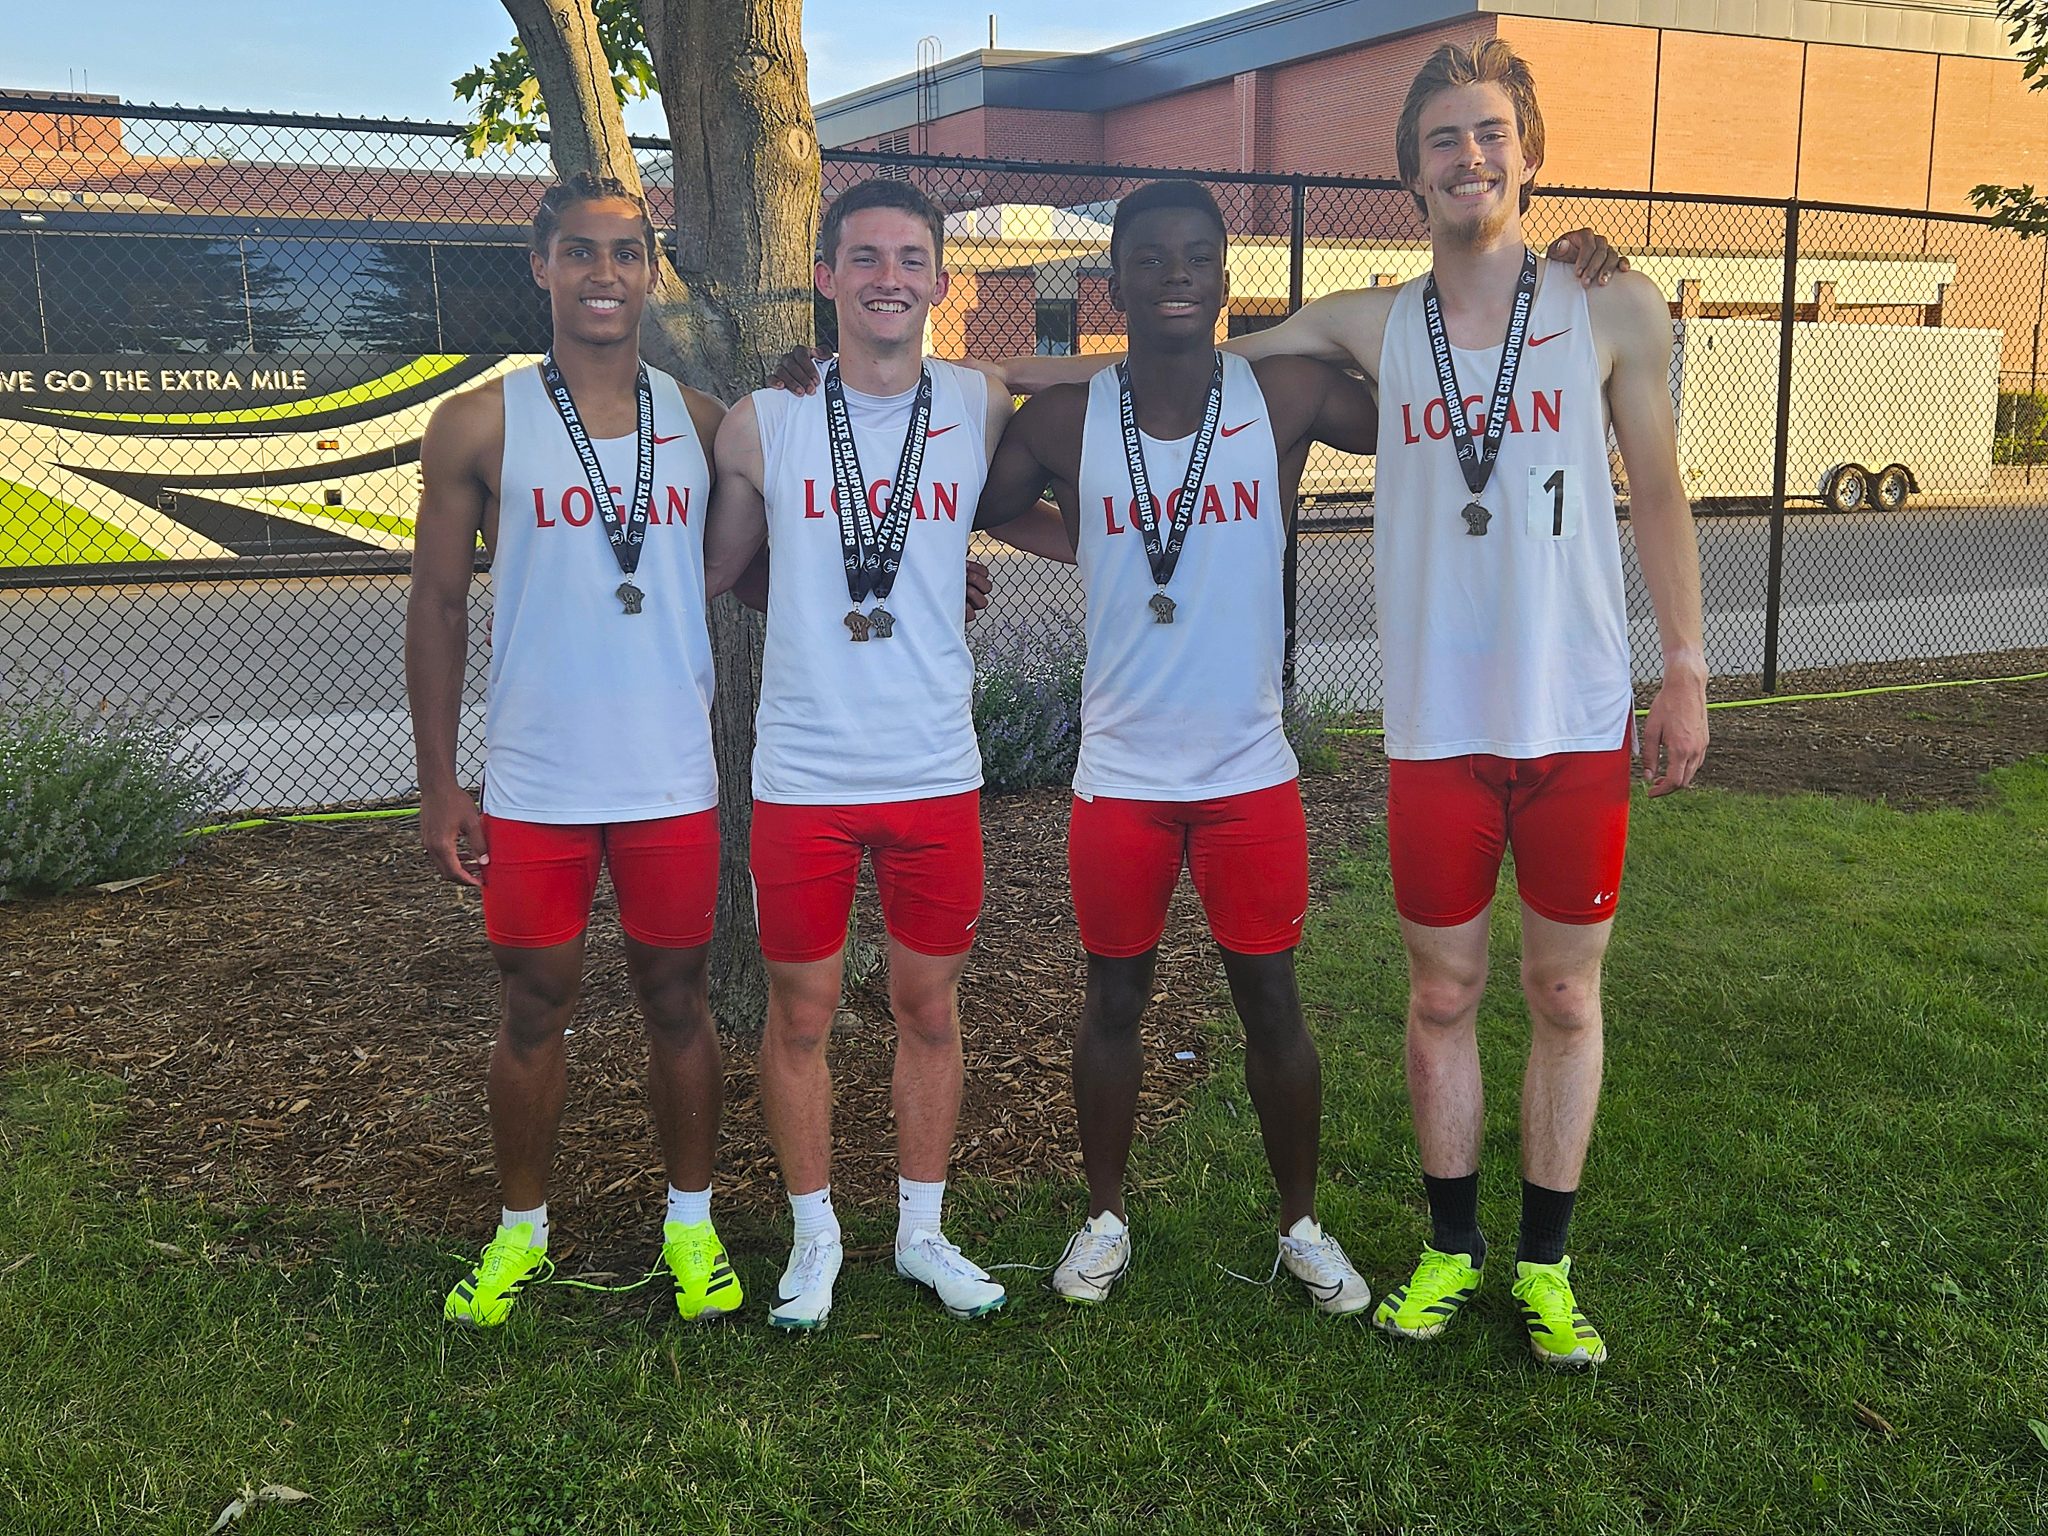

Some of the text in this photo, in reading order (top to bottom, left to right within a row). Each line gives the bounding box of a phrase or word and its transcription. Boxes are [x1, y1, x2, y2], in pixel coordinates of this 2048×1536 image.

[44, 370, 93, 392] GO
[100, 370, 152, 392] THE
[160, 370, 242, 392] EXTRA
[251, 370, 307, 391] MILE
[1402, 389, 1563, 444] LOGAN
[1427, 297, 1466, 437] STATE CHAMPIONSHIPS
[1488, 291, 1530, 438] STATE CHAMPIONSHIPS
[554, 387, 617, 524] STATE CHAMPIONSHIPS
[633, 389, 651, 523] STATE CHAMPIONSHIPS
[803, 479, 958, 522] LGAN
[831, 399, 875, 546] STATE CHAMPIONSHIPS
[890, 510, 909, 552] STATE
[901, 406, 928, 510] CHAMPIONSHIPS
[1121, 390, 1155, 532] STATE CHAMPIONSHIPS
[1174, 388, 1220, 532] STATE CHAMPIONSHIPS
[1543, 470, 1564, 536] 1
